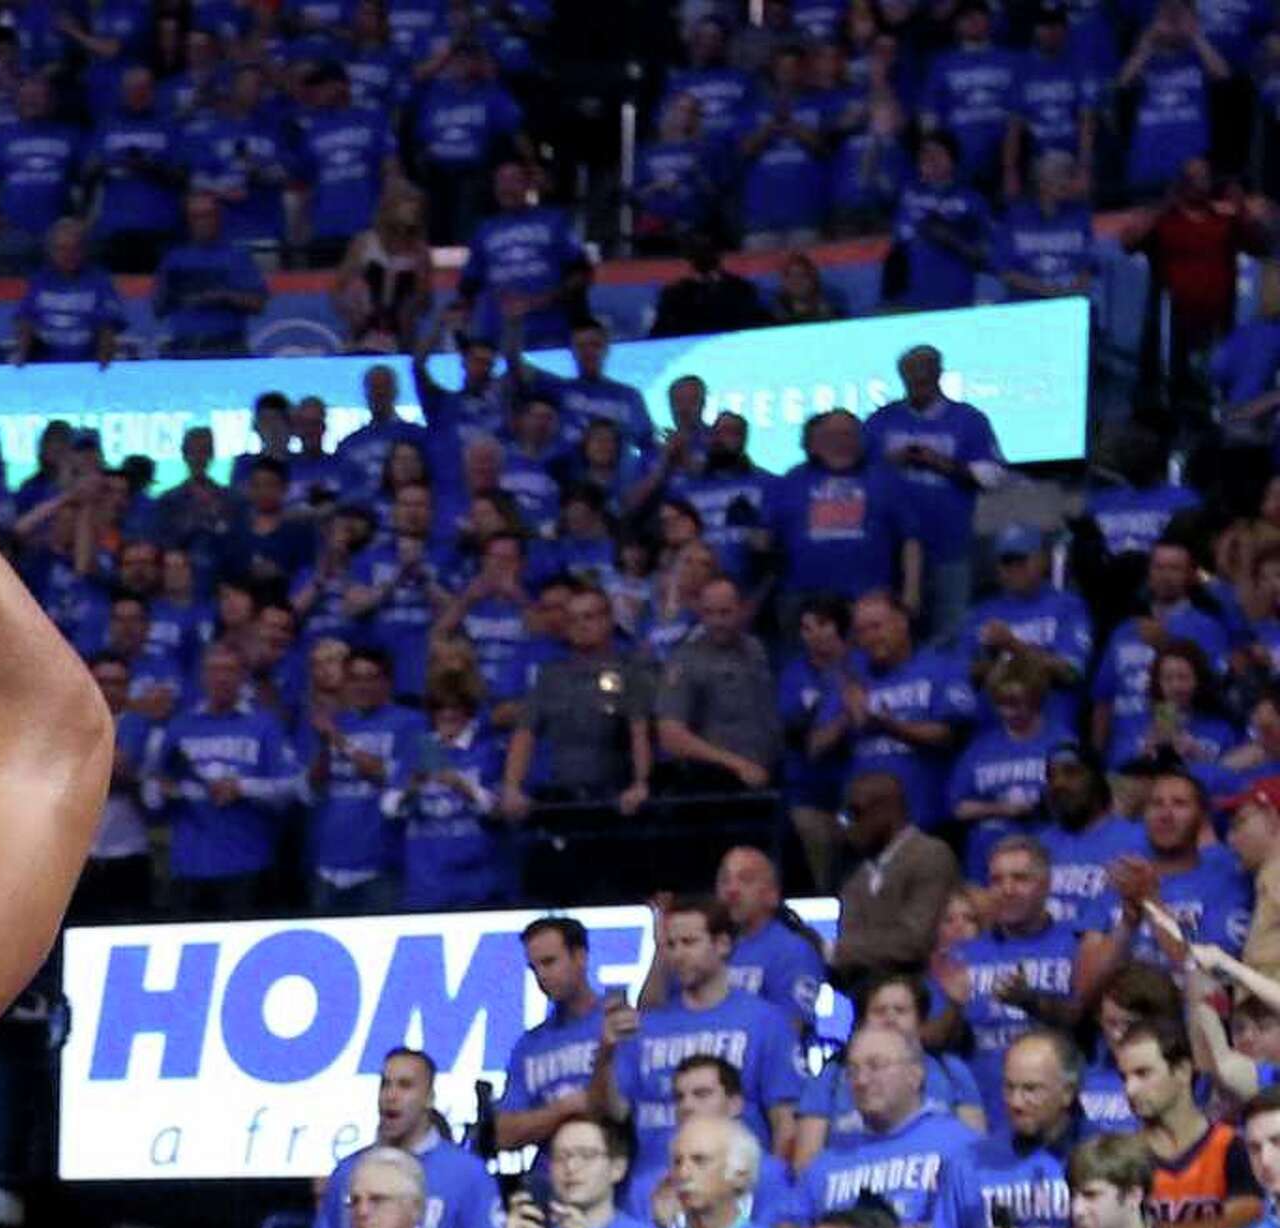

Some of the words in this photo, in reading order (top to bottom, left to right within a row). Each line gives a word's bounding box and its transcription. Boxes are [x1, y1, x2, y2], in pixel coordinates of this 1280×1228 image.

[149, 1125, 182, 1167] a
[242, 1107, 361, 1166] fre
[826, 1153, 941, 1211] THUNDER
[981, 1177, 1072, 1228] THUND
